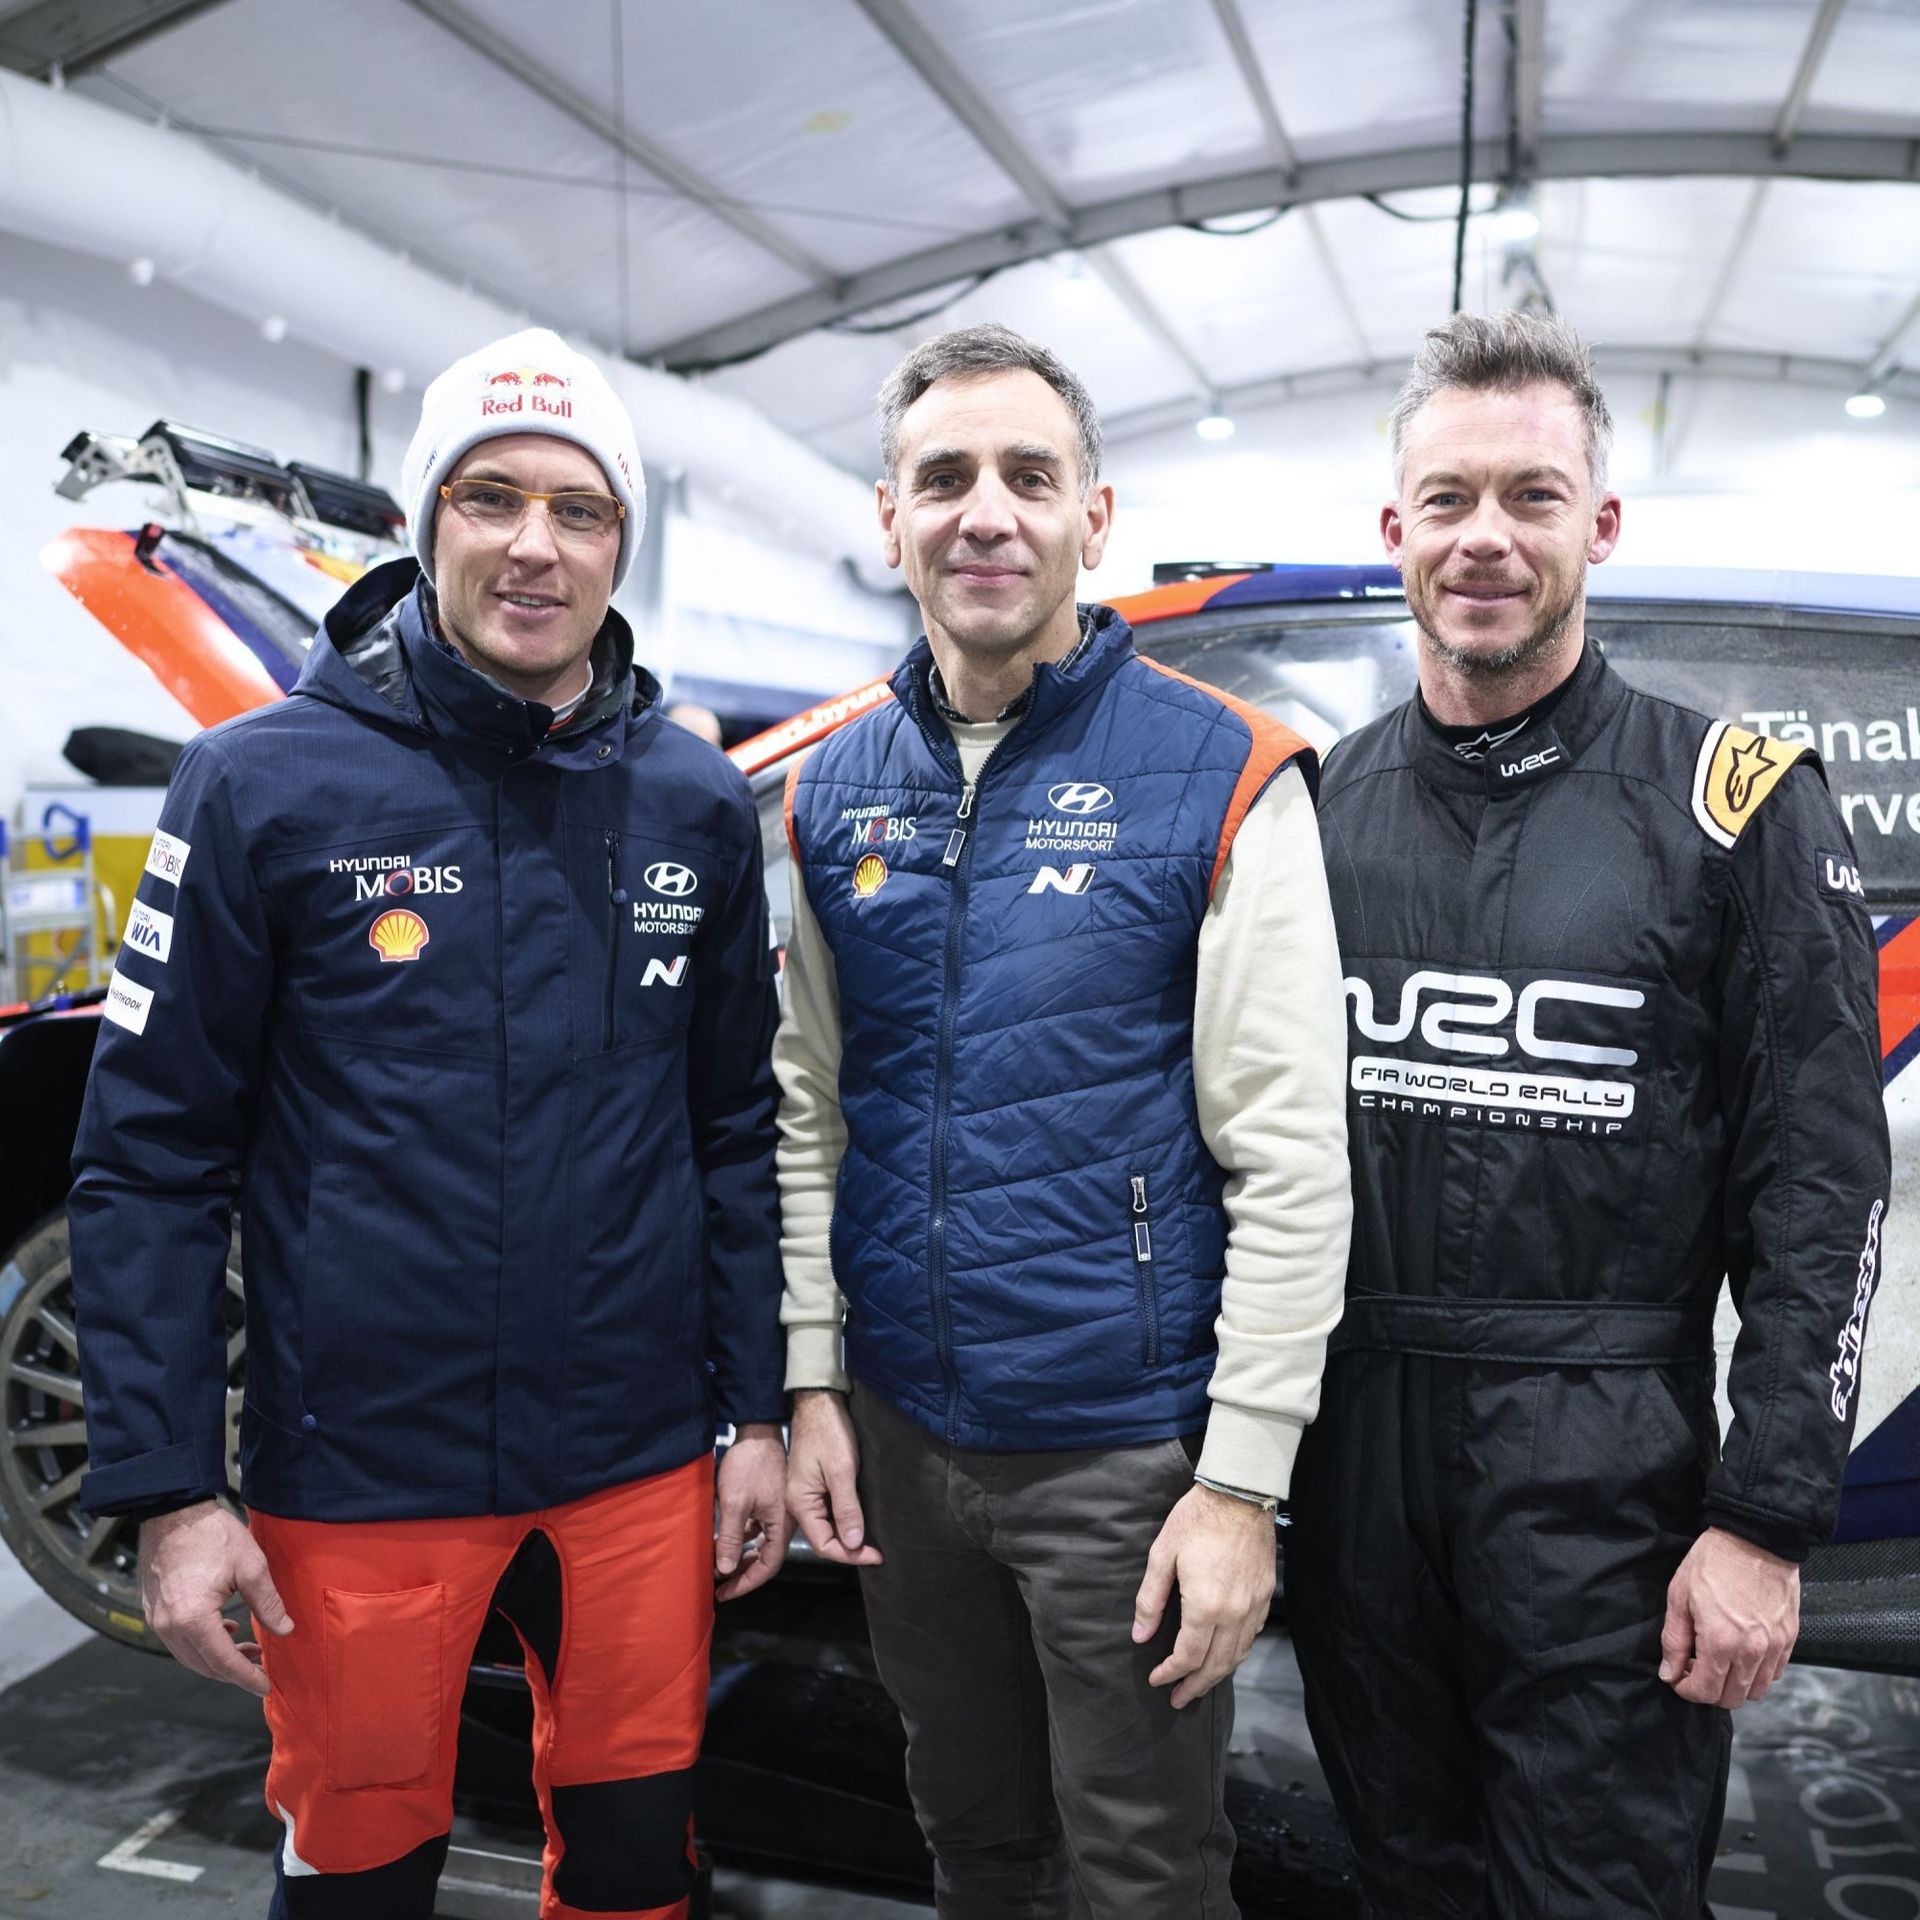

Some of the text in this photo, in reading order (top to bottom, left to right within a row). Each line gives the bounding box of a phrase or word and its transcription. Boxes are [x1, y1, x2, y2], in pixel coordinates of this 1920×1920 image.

[482, 394, 572, 418] Red Bull
[1500, 746, 1560, 777] WRC
[841, 805, 890, 820] HYUNDAI
[851, 817, 917, 844] MOBIS
[1028, 819, 1118, 838] HYUNDAI
[1025, 838, 1114, 852] MOTORSPORT
[329, 855, 411, 873] HYUNDAI
[355, 865, 464, 902] MOBIS
[1360, 1067, 1626, 1108] FIA WORLD RALLY
[1359, 1095, 1622, 1135] CHAMPIONSHIP
